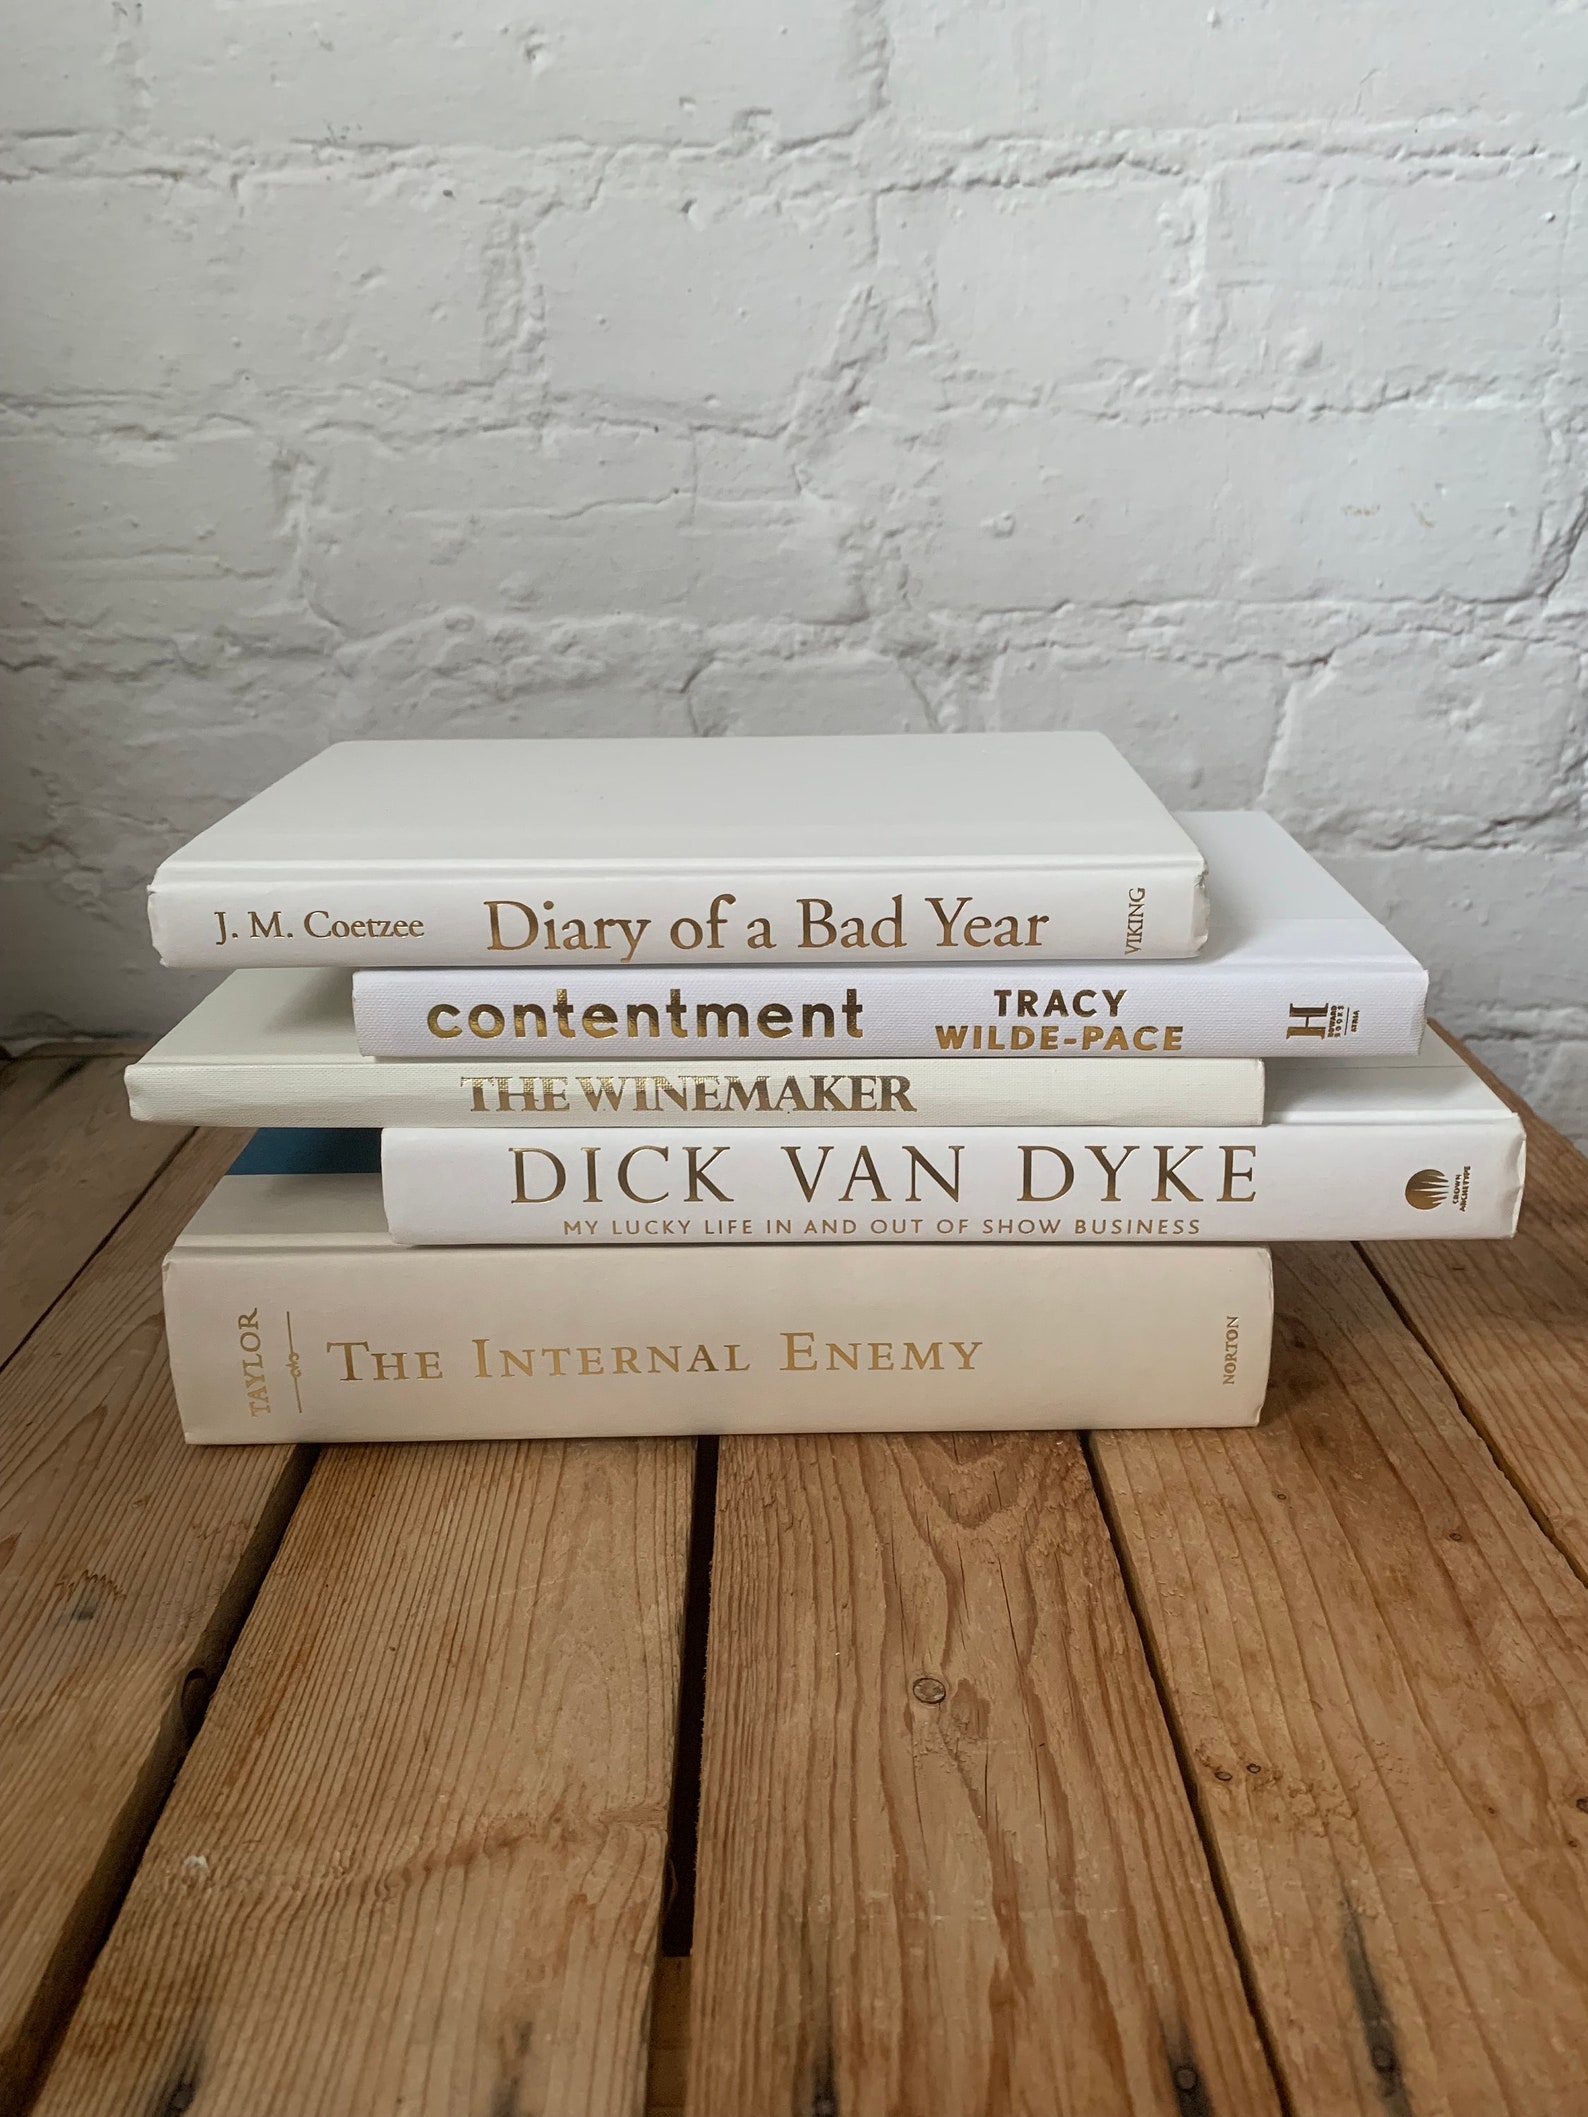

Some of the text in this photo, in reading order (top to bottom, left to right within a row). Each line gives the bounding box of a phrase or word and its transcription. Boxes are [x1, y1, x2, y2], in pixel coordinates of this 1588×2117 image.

[214, 910, 425, 945] J. M. Coetzee
[484, 893, 1050, 963] Diary of a Bad Year
[1124, 887, 1146, 955] VIKING
[427, 988, 864, 1039] contentment
[994, 988, 1127, 1018] TRACY
[935, 1025, 1184, 1051] WILDE-PACE
[460, 1074, 918, 1113] THE WINEMAKER
[508, 1144, 1257, 1204] DICK VAN DYKE
[1452, 1174, 1462, 1205] CROWN
[1459, 1165, 1471, 1213] ARCHETYPE
[563, 1218, 1201, 1236] MY LUCKY LIFE IN AND OUT OF SHOW BUSINESS
[238, 1307, 271, 1418] TAYLOR
[326, 1331, 984, 1381] THE INTERNAL ENEMY
[1222, 1315, 1239, 1386] NORTON
